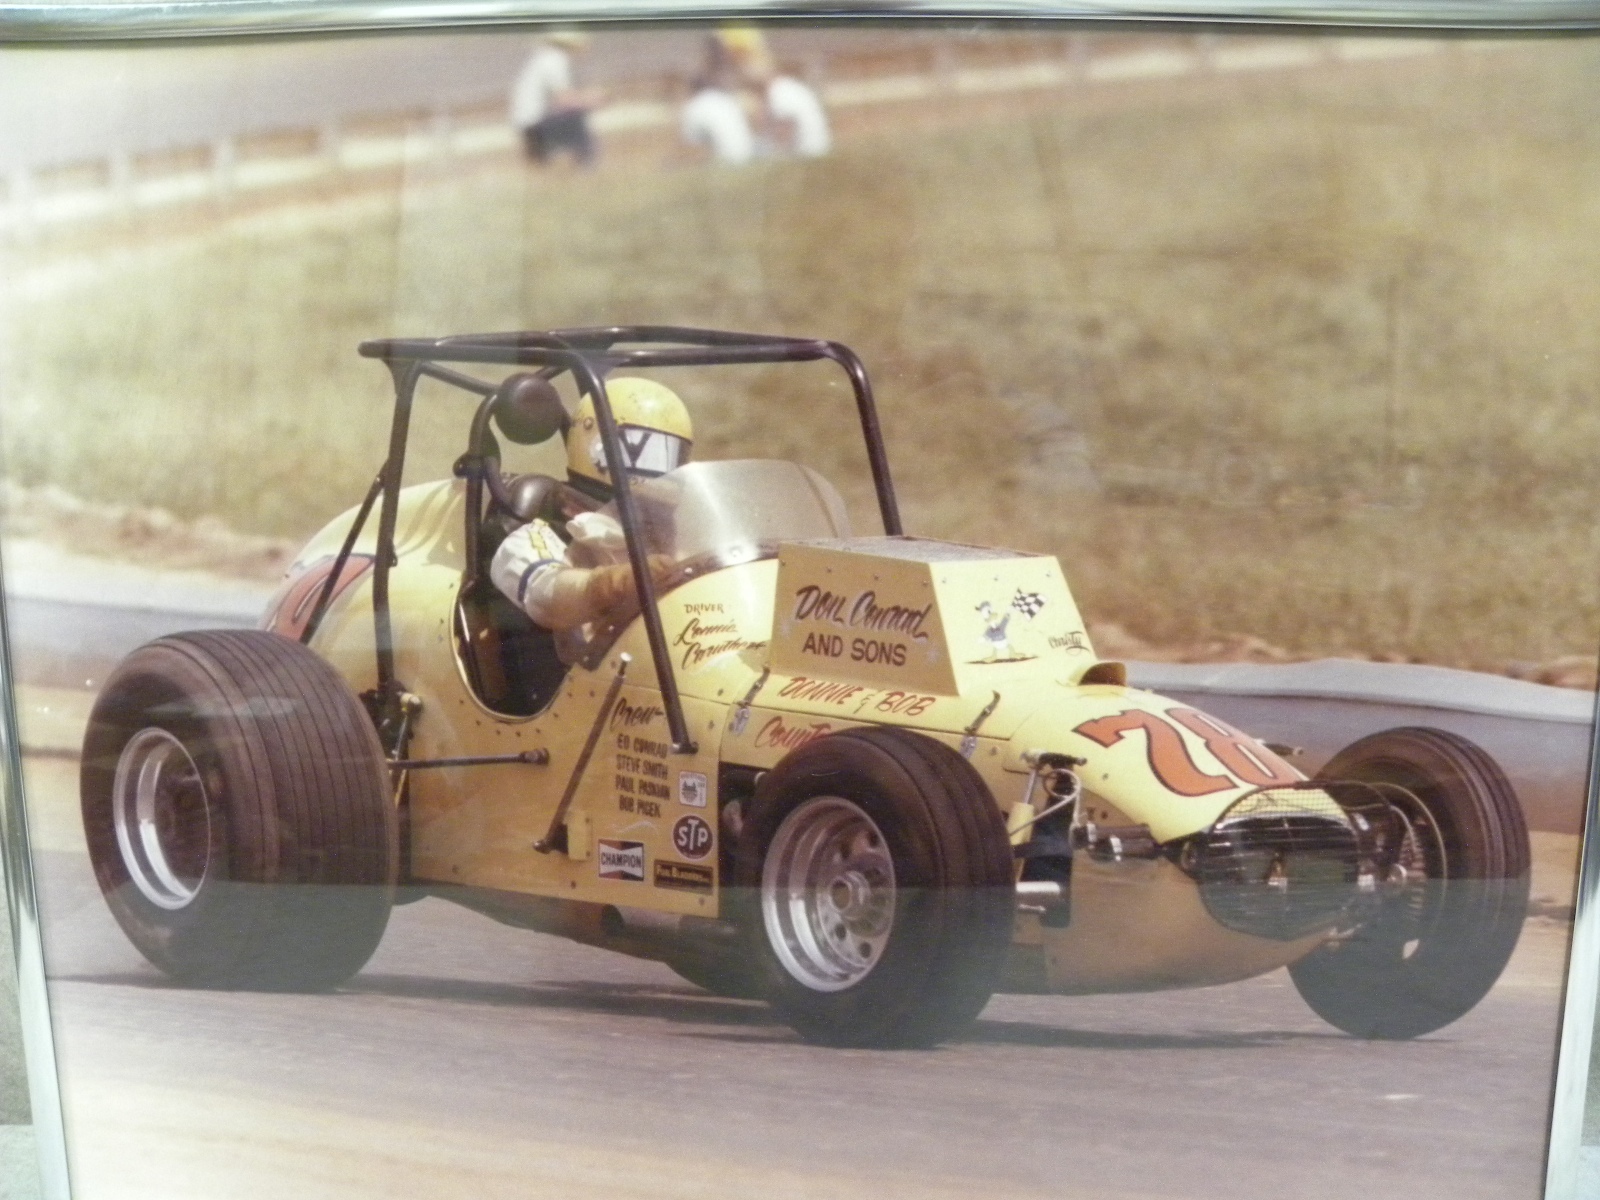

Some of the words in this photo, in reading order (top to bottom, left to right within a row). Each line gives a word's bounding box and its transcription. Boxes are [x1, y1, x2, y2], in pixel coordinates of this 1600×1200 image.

[684, 603, 724, 615] DRIVER
[802, 632, 843, 657] AND
[850, 637, 907, 667] SONS
[875, 691, 936, 716] BOB
[1071, 707, 1302, 797] 78
[677, 819, 708, 851] STP
[601, 852, 642, 868] CHAMPION
